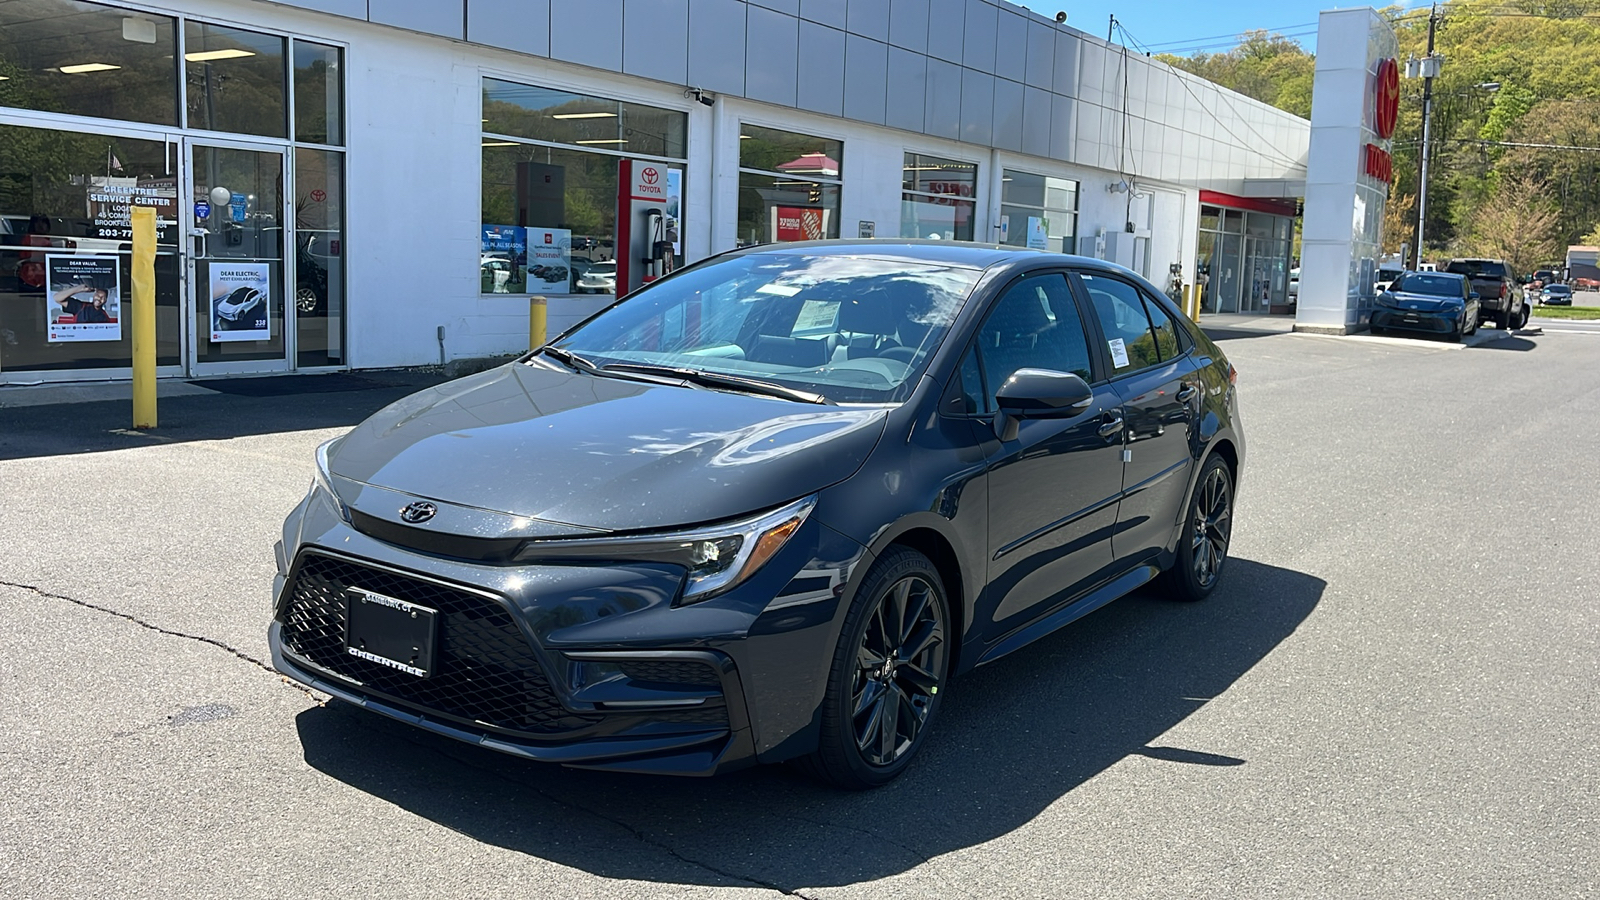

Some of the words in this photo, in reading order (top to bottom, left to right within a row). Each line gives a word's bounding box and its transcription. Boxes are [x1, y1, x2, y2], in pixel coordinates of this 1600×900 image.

[104, 186, 158, 196] GREENTREE
[639, 184, 661, 194] TOYOTA
[90, 194, 131, 204] SERVICE
[135, 197, 170, 206] CENTER
[401, 603, 412, 612] CT
[348, 647, 424, 677] GREENTREE
